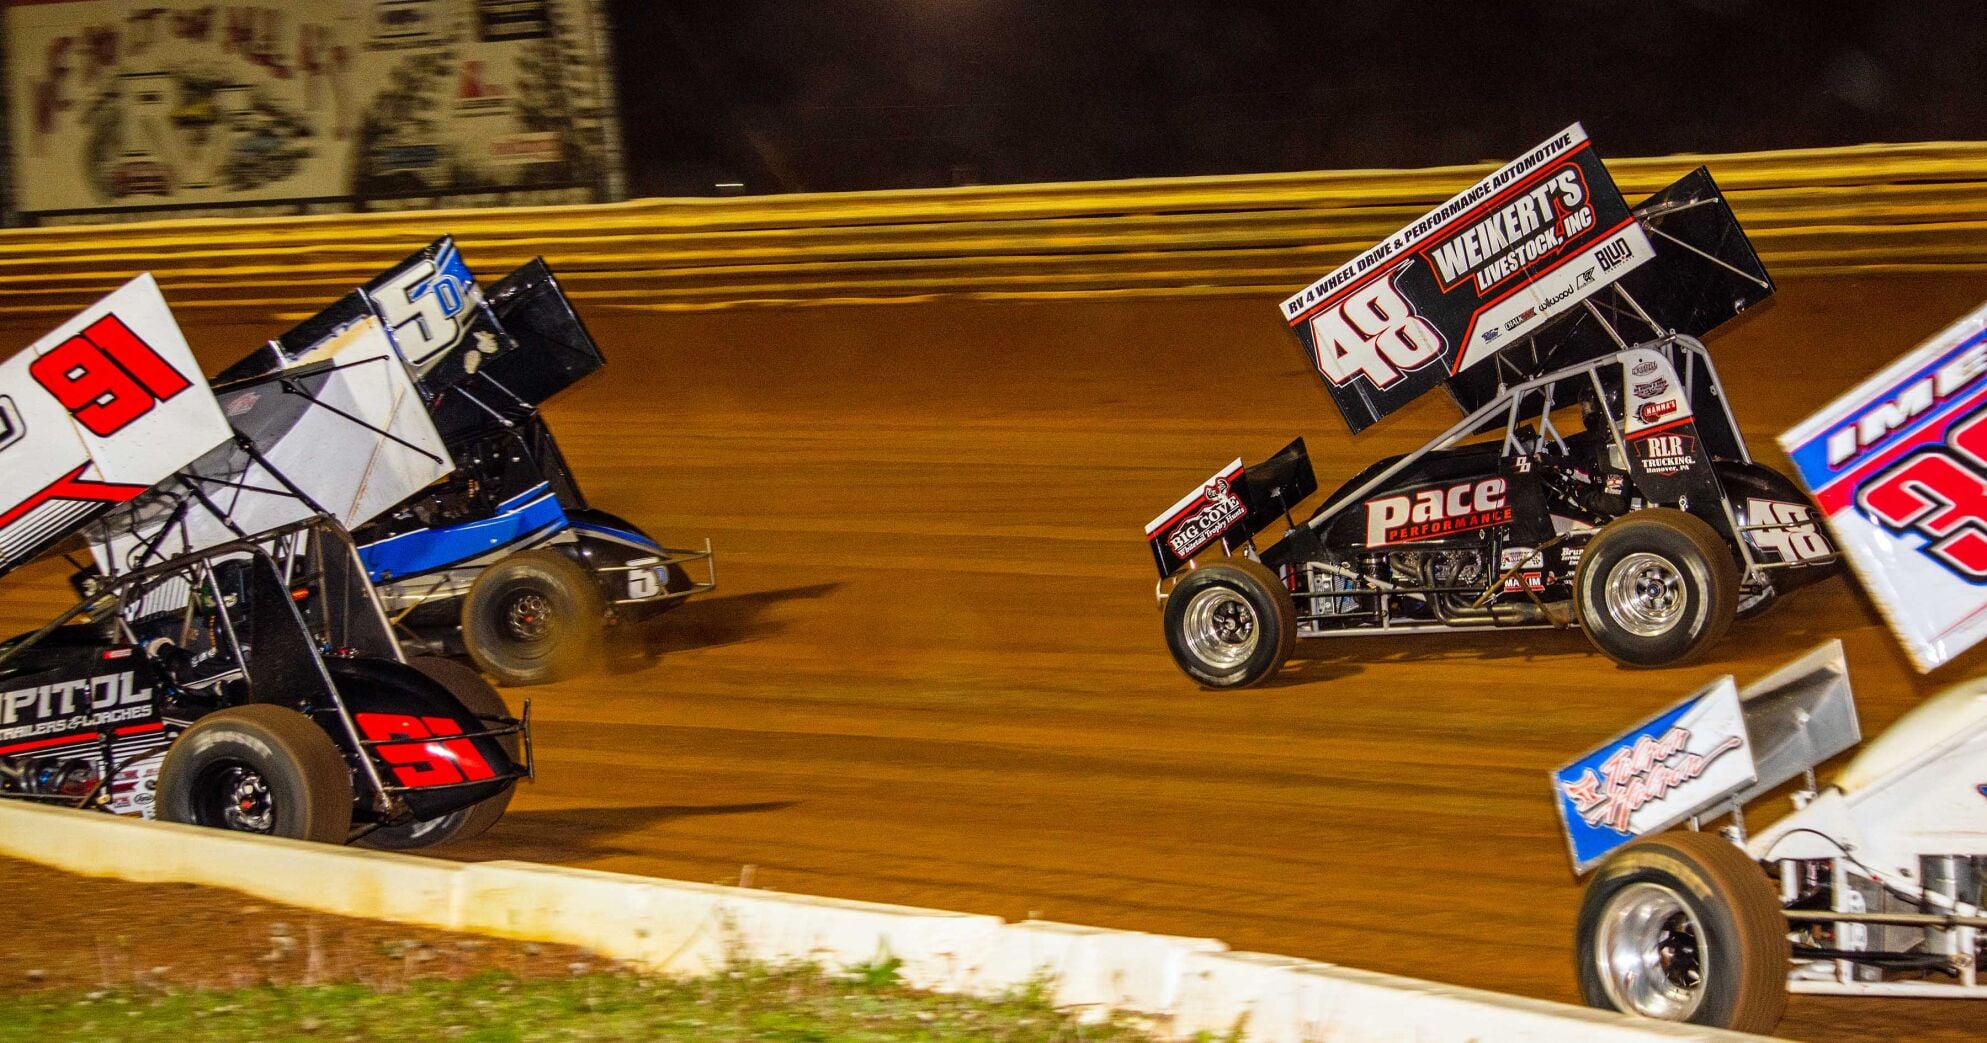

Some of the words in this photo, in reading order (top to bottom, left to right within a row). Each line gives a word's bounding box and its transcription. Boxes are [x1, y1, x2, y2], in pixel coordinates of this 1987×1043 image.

[1288, 299, 1304, 314] RV
[1306, 291, 1316, 303] 4
[1315, 266, 1356, 298] WHEEL
[1356, 244, 1393, 272] DRIVE
[1393, 238, 1404, 249] &
[1404, 182, 1492, 243] PERFORMANCE
[1493, 133, 1572, 190] AUTOMOTIVE
[1432, 170, 1583, 283] WEIKERT'S
[1476, 226, 1564, 291] LIVESTOCK,
[1563, 207, 1593, 236] INC
[1310, 259, 1448, 392] 48
[29, 311, 194, 438] 91
[1647, 436, 1684, 457] RLR
[1170, 526, 1199, 550] BIG
[1199, 496, 1240, 529] COVE
[1178, 533, 1206, 556] Whitetail
[1204, 520, 1227, 540] Trophy
[1226, 507, 1245, 523] Hunts
[1389, 507, 1512, 541] PERFORMANCE
[1747, 498, 1835, 566] 48
[0, 670, 153, 725] PITOL
